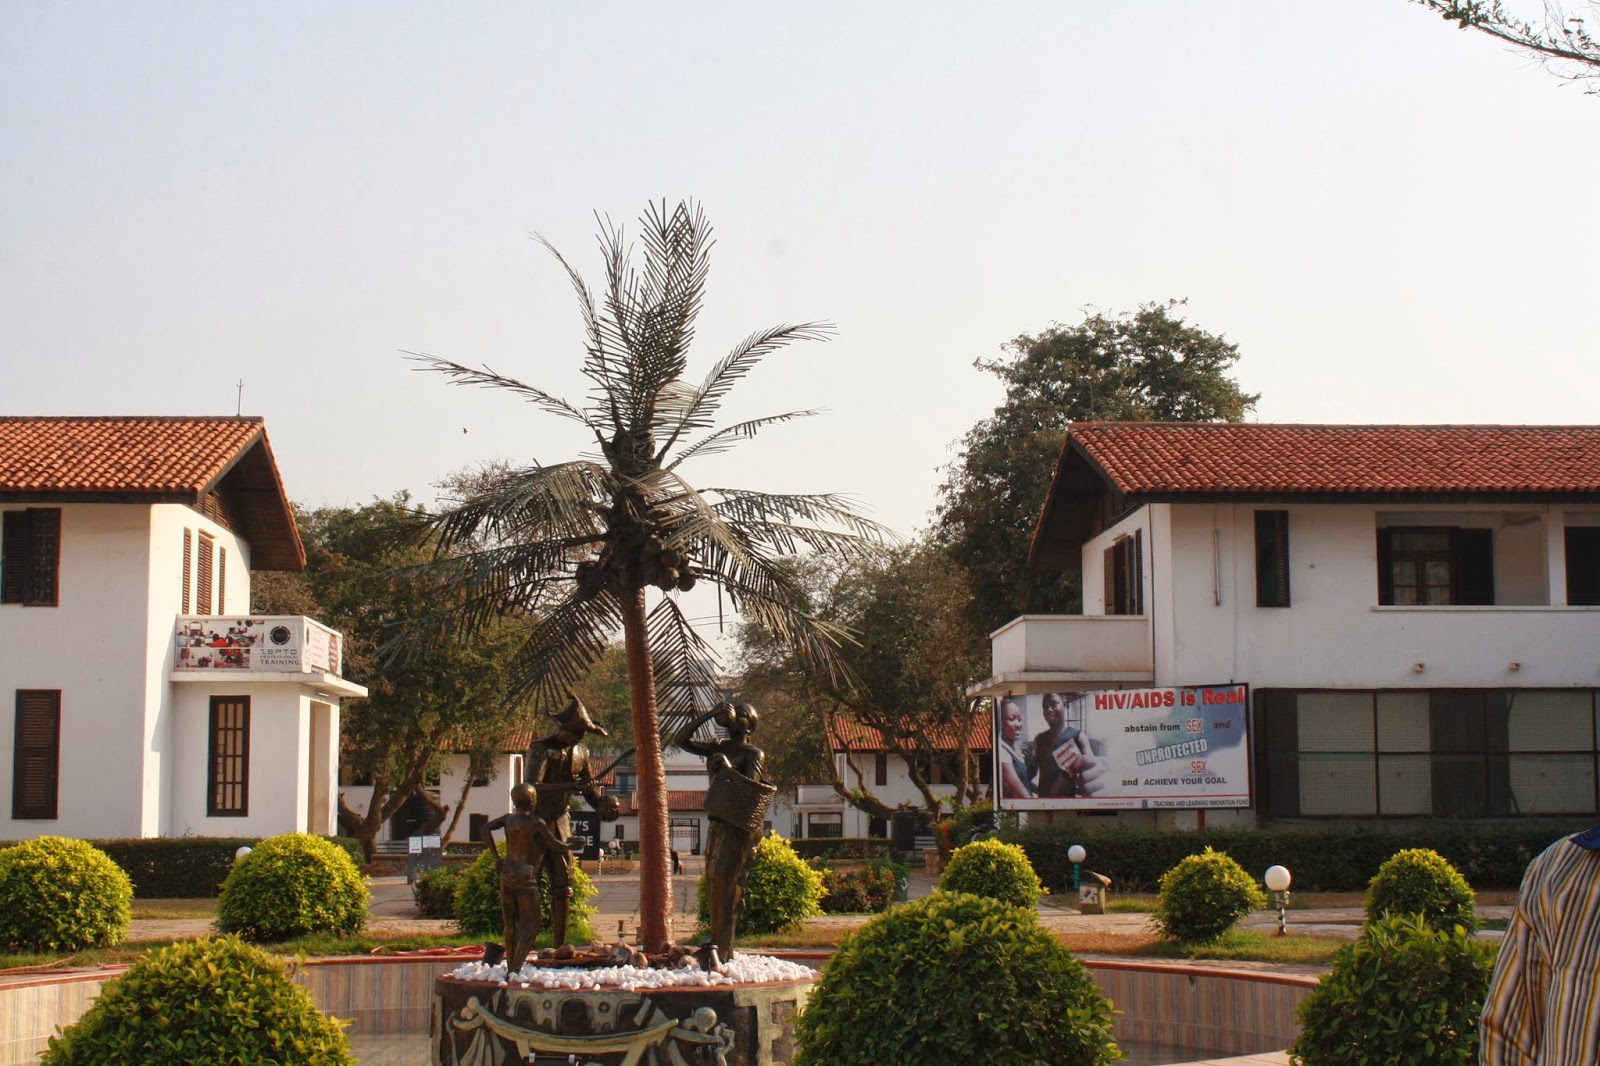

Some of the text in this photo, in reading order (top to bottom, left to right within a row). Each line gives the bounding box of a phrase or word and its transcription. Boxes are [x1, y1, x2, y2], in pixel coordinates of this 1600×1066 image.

[1095, 687, 1245, 710] HIV/AIDS is Real
[1124, 719, 1231, 733] abstain from SEX and
[1136, 739, 1208, 766] UNPROTECTED
[1191, 760, 1208, 774] SEX
[1122, 776, 1227, 786] and ACHIEVE YOUR GOAL
[1209, 799, 1236, 807] INNOVATION
